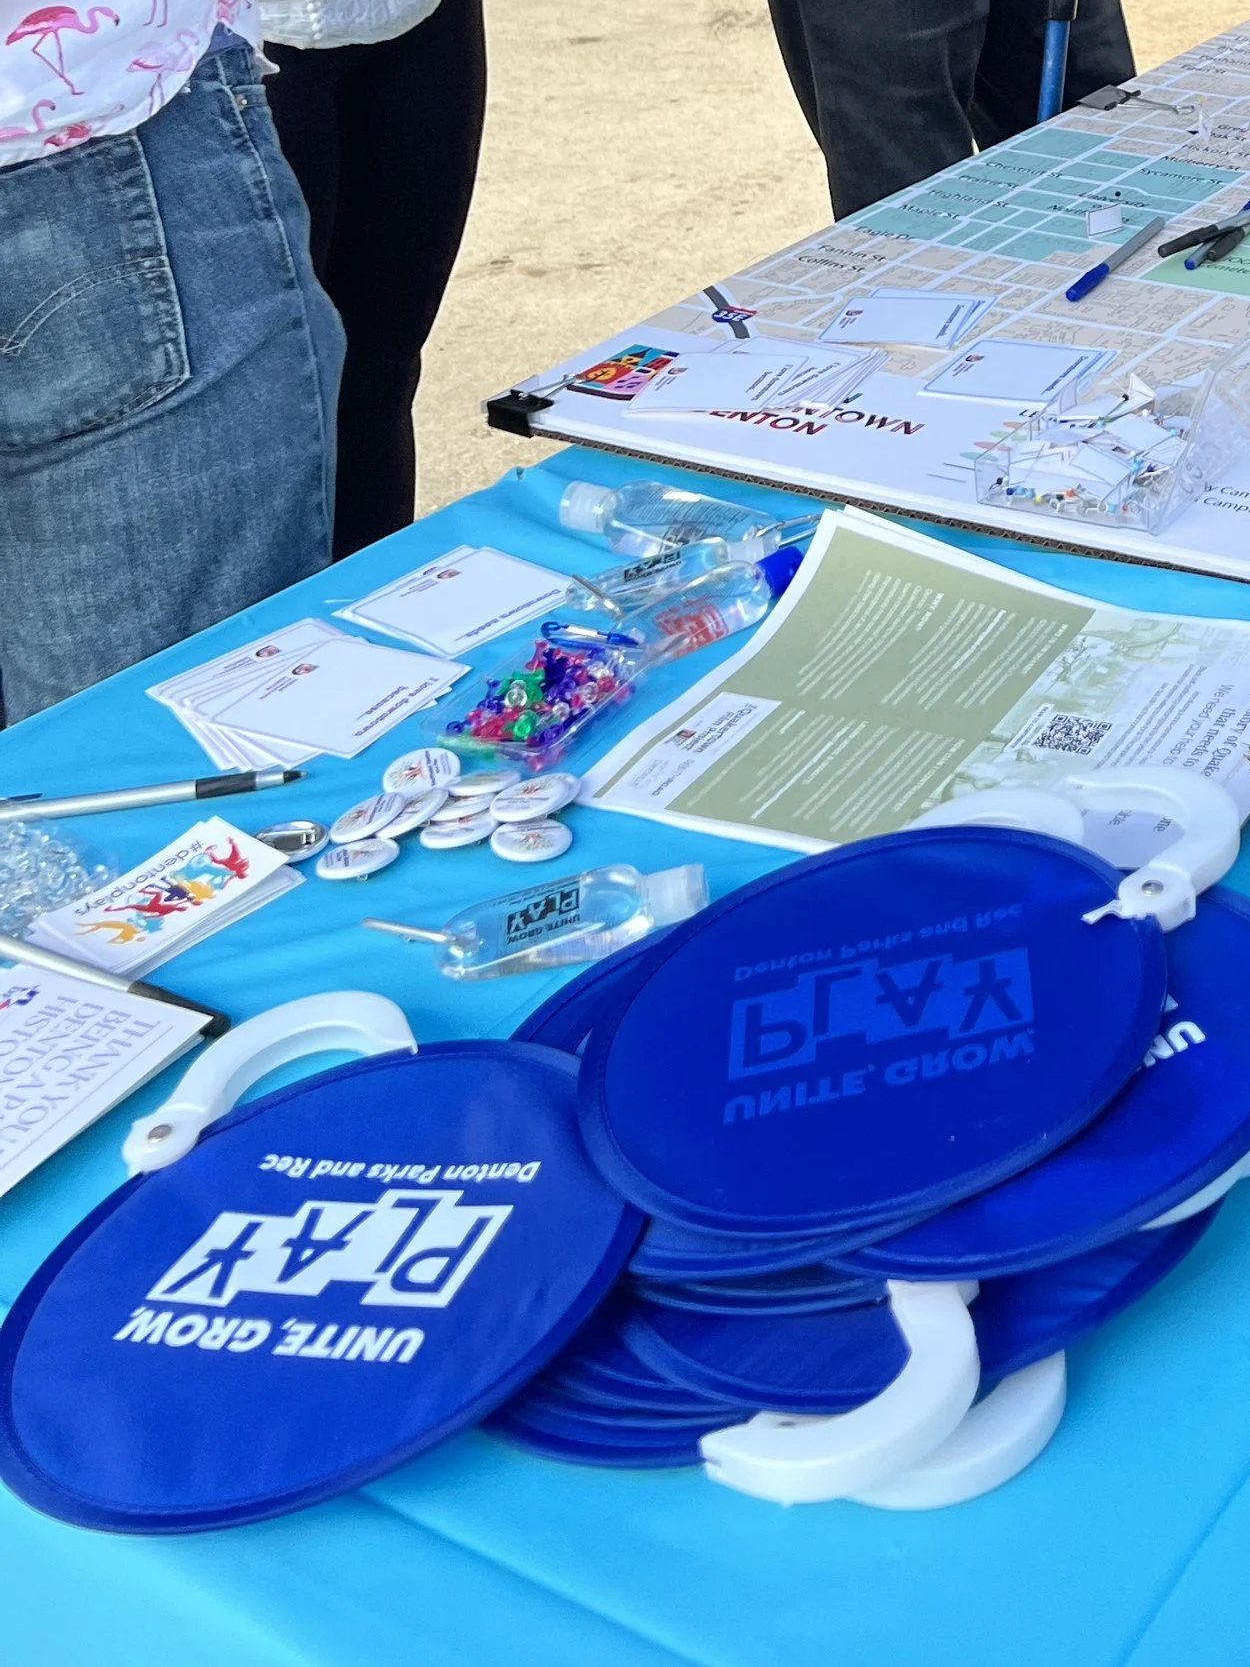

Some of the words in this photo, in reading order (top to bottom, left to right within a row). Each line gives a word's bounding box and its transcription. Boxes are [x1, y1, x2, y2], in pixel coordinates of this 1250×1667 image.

[1181, 142, 1236, 159] Hickory
[985, 161, 1046, 177] Chestnut
[1161, 154, 1220, 170] Mulberry
[1139, 168, 1204, 185] Sycamore
[928, 189, 992, 206] Highland
[899, 204, 940, 218] Maple
[854, 225, 893, 240] Eagle
[818, 244, 868, 259] Fannin
[798, 255, 848, 271] Collins
[710, 408, 828, 436] ENTON
[1198, 697, 1220, 720] need
[1214, 708, 1237, 727] that
[697, 707, 753, 752] Quakertown
[1185, 718, 1203, 737] your
[1191, 728, 1219, 756] needs
[74, 838, 204, 918] #dentonplays
[507, 889, 581, 934] PLAY
[42, 1009, 132, 1073] BEING
[56, 1020, 160, 1091] THANK
[257, 1153, 308, 1179] Rec
[312, 1159, 362, 1180] and
[367, 1163, 441, 1185] Parks
[444, 1160, 542, 1184] Denton
[146, 1189, 514, 1308] PLAY
[112, 1306, 273, 1353] GROW,
[271, 1318, 426, 1364] UNITE,
